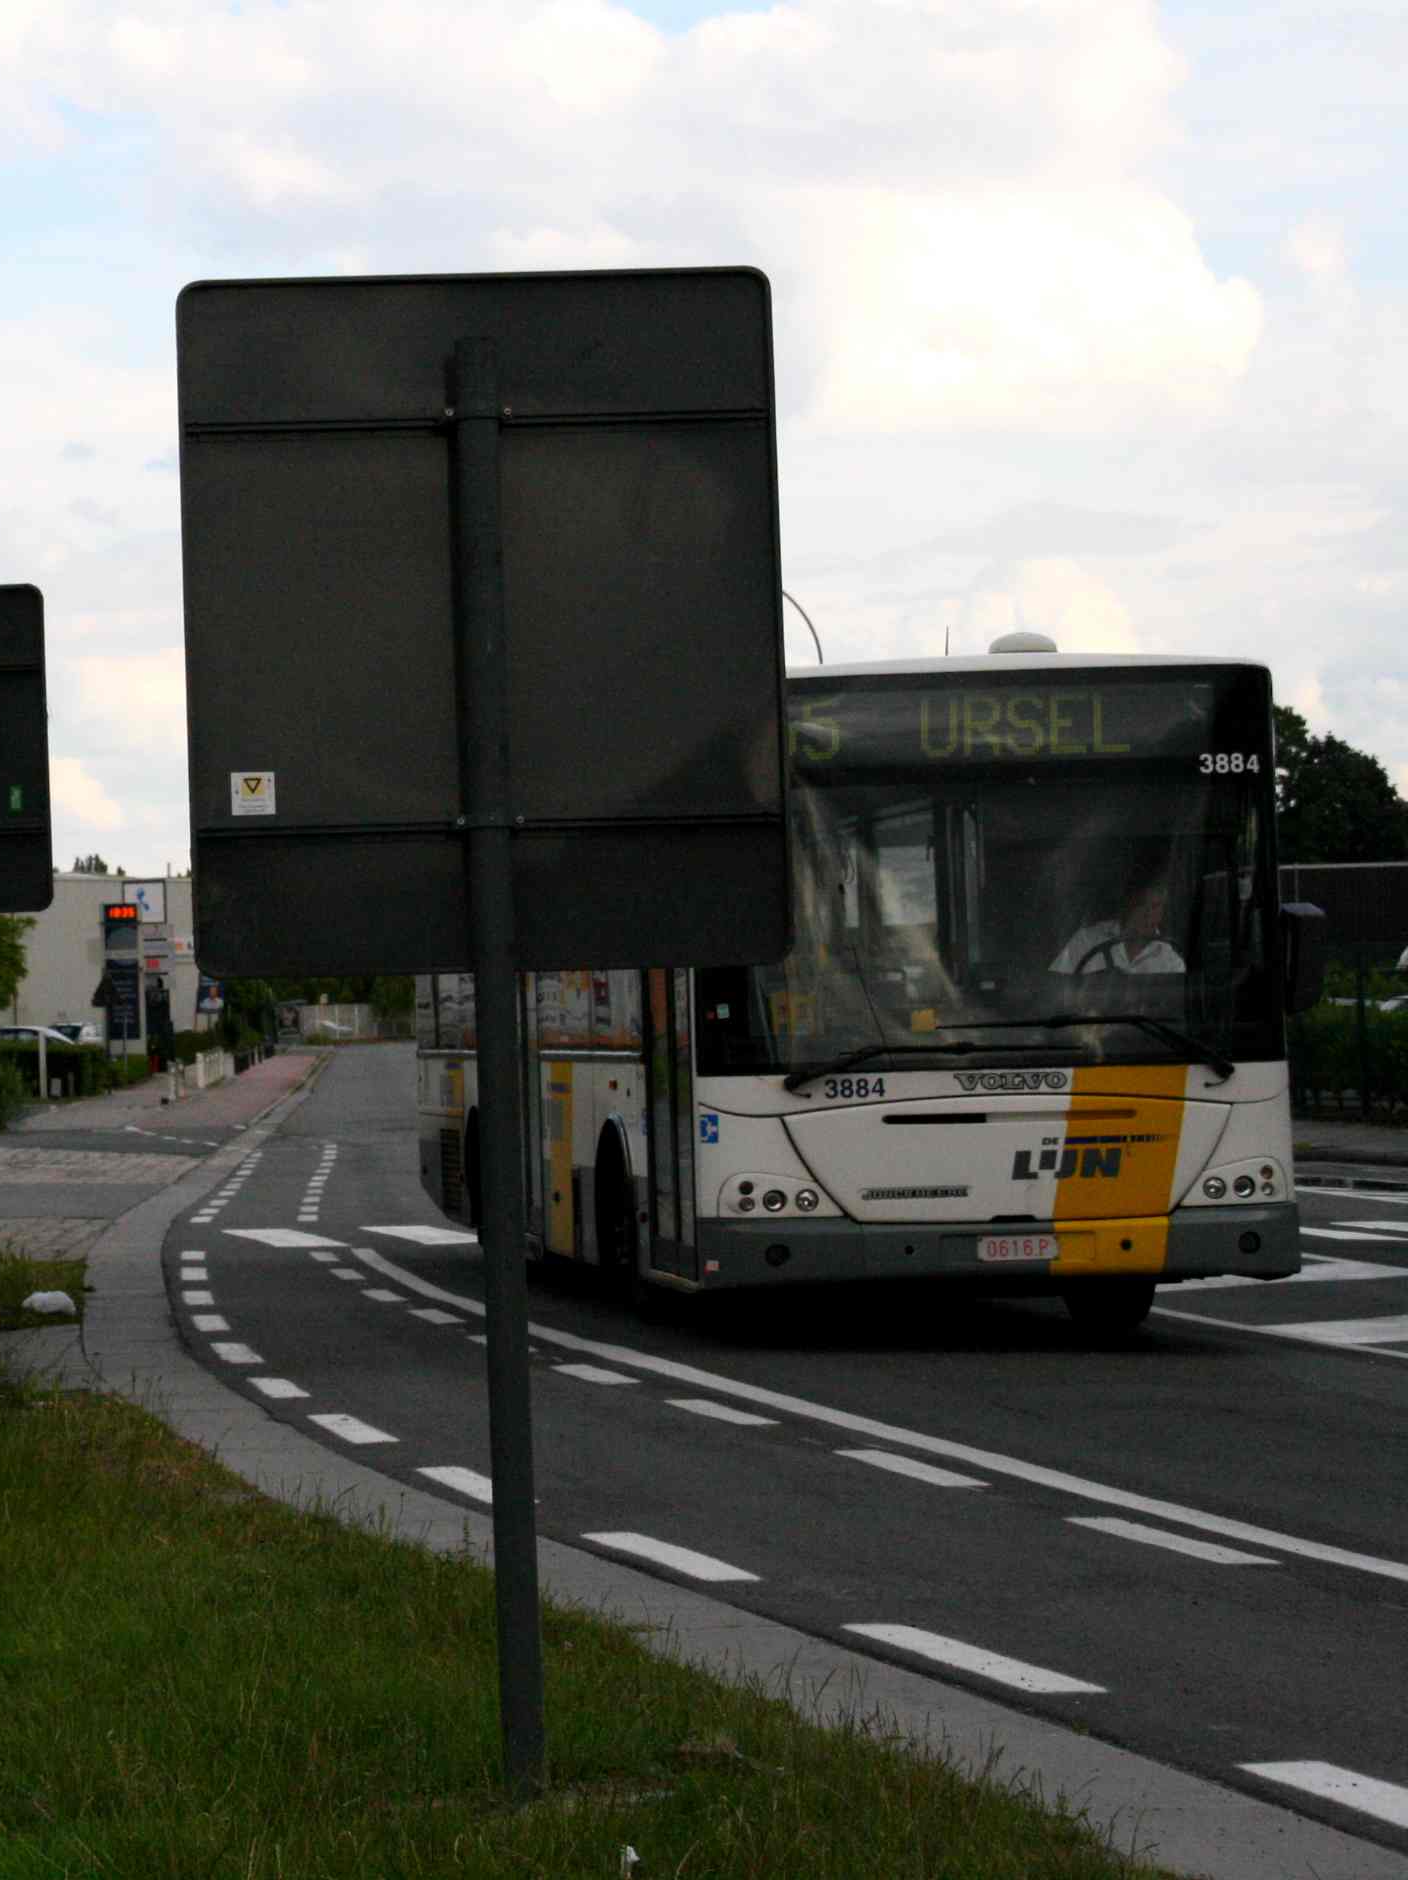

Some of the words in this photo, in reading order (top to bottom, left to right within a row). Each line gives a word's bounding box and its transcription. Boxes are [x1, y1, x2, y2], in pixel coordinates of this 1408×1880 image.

[785, 697, 842, 761] 5
[919, 696, 1132, 759] URSEL
[1198, 752, 1261, 775] 3884
[823, 1076, 886, 1098] 3884
[953, 1071, 1069, 1092] VOLVO
